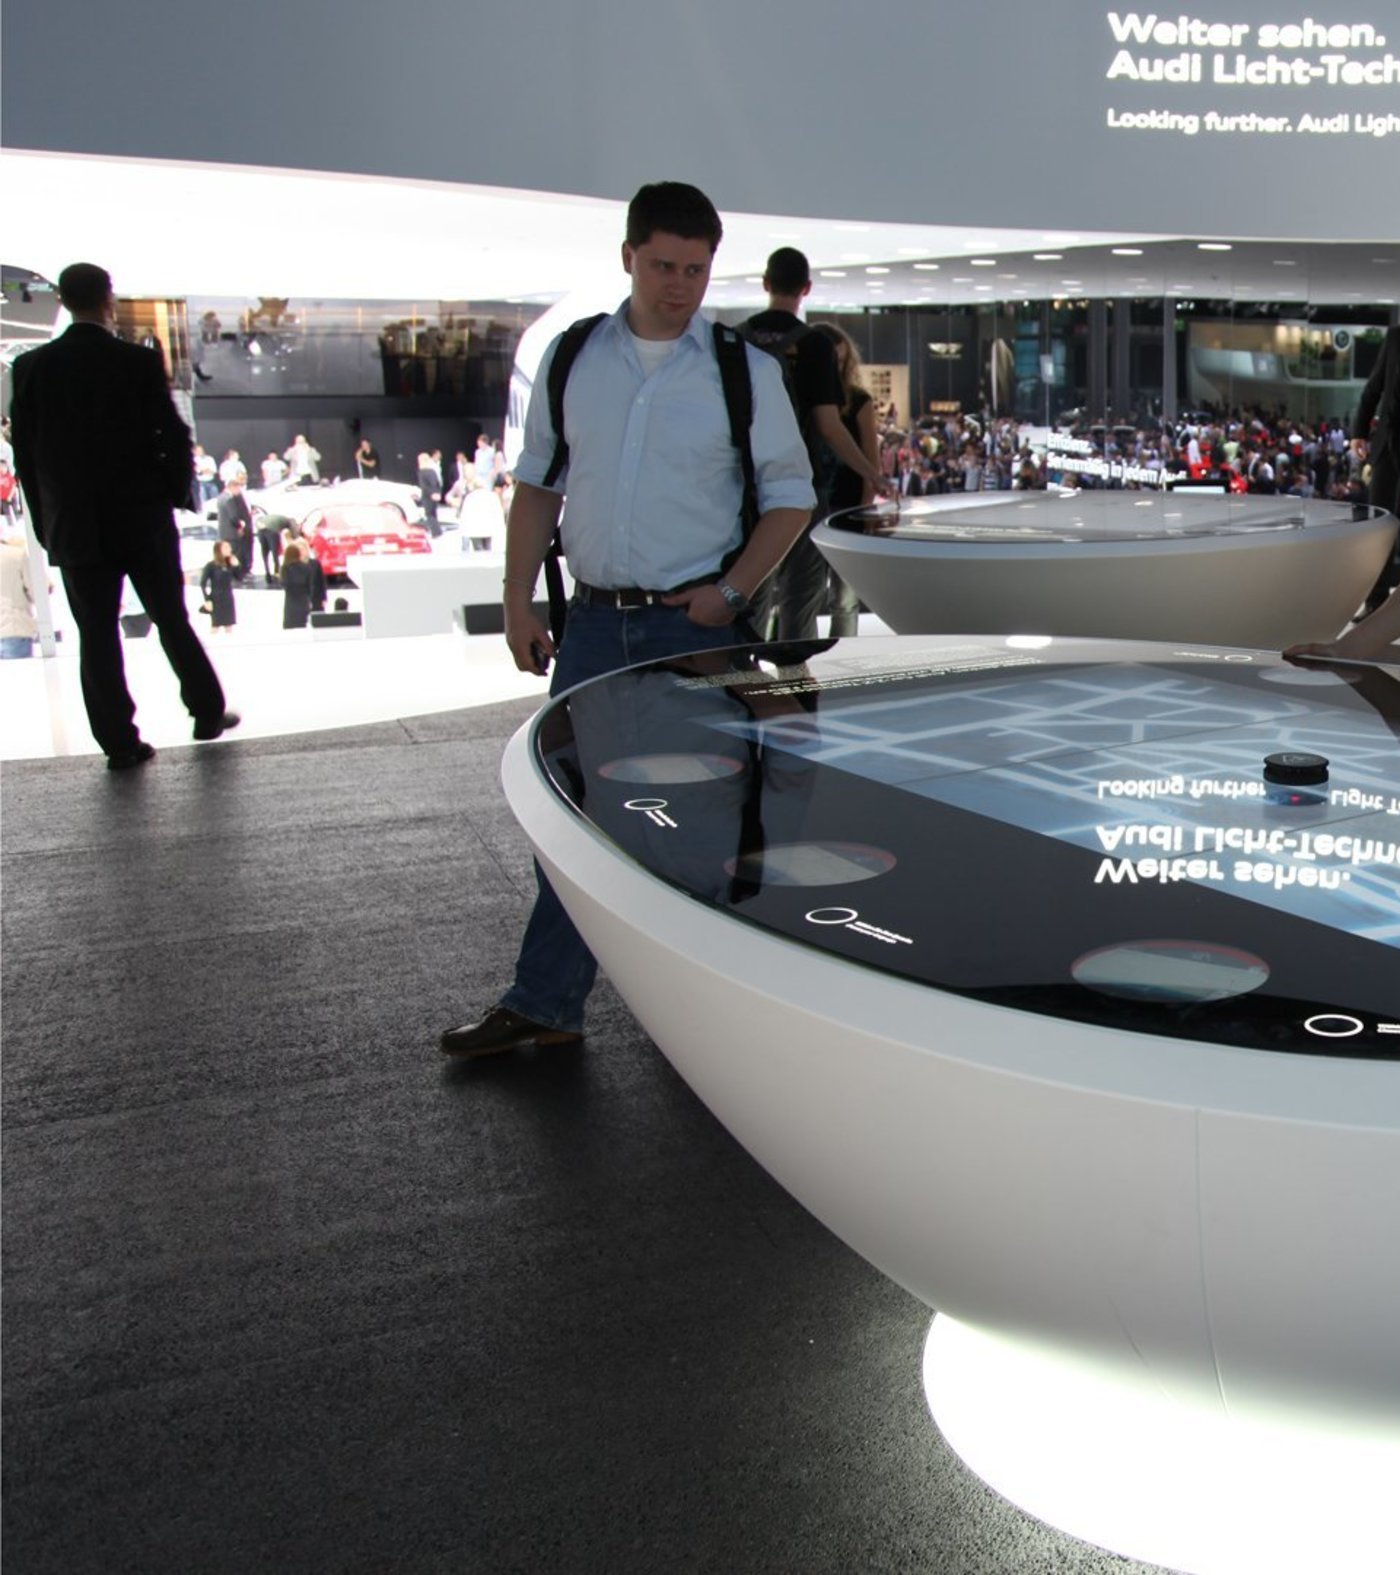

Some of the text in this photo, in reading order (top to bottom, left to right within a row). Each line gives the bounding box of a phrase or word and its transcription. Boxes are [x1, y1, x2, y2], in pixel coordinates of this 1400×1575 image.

[1107, 12, 1386, 48] Weiter sehen.
[1106, 49, 1202, 83] Audi
[1107, 108, 1200, 135] Looking
[1203, 111, 1293, 134] further.
[1296, 113, 1350, 133] Audi
